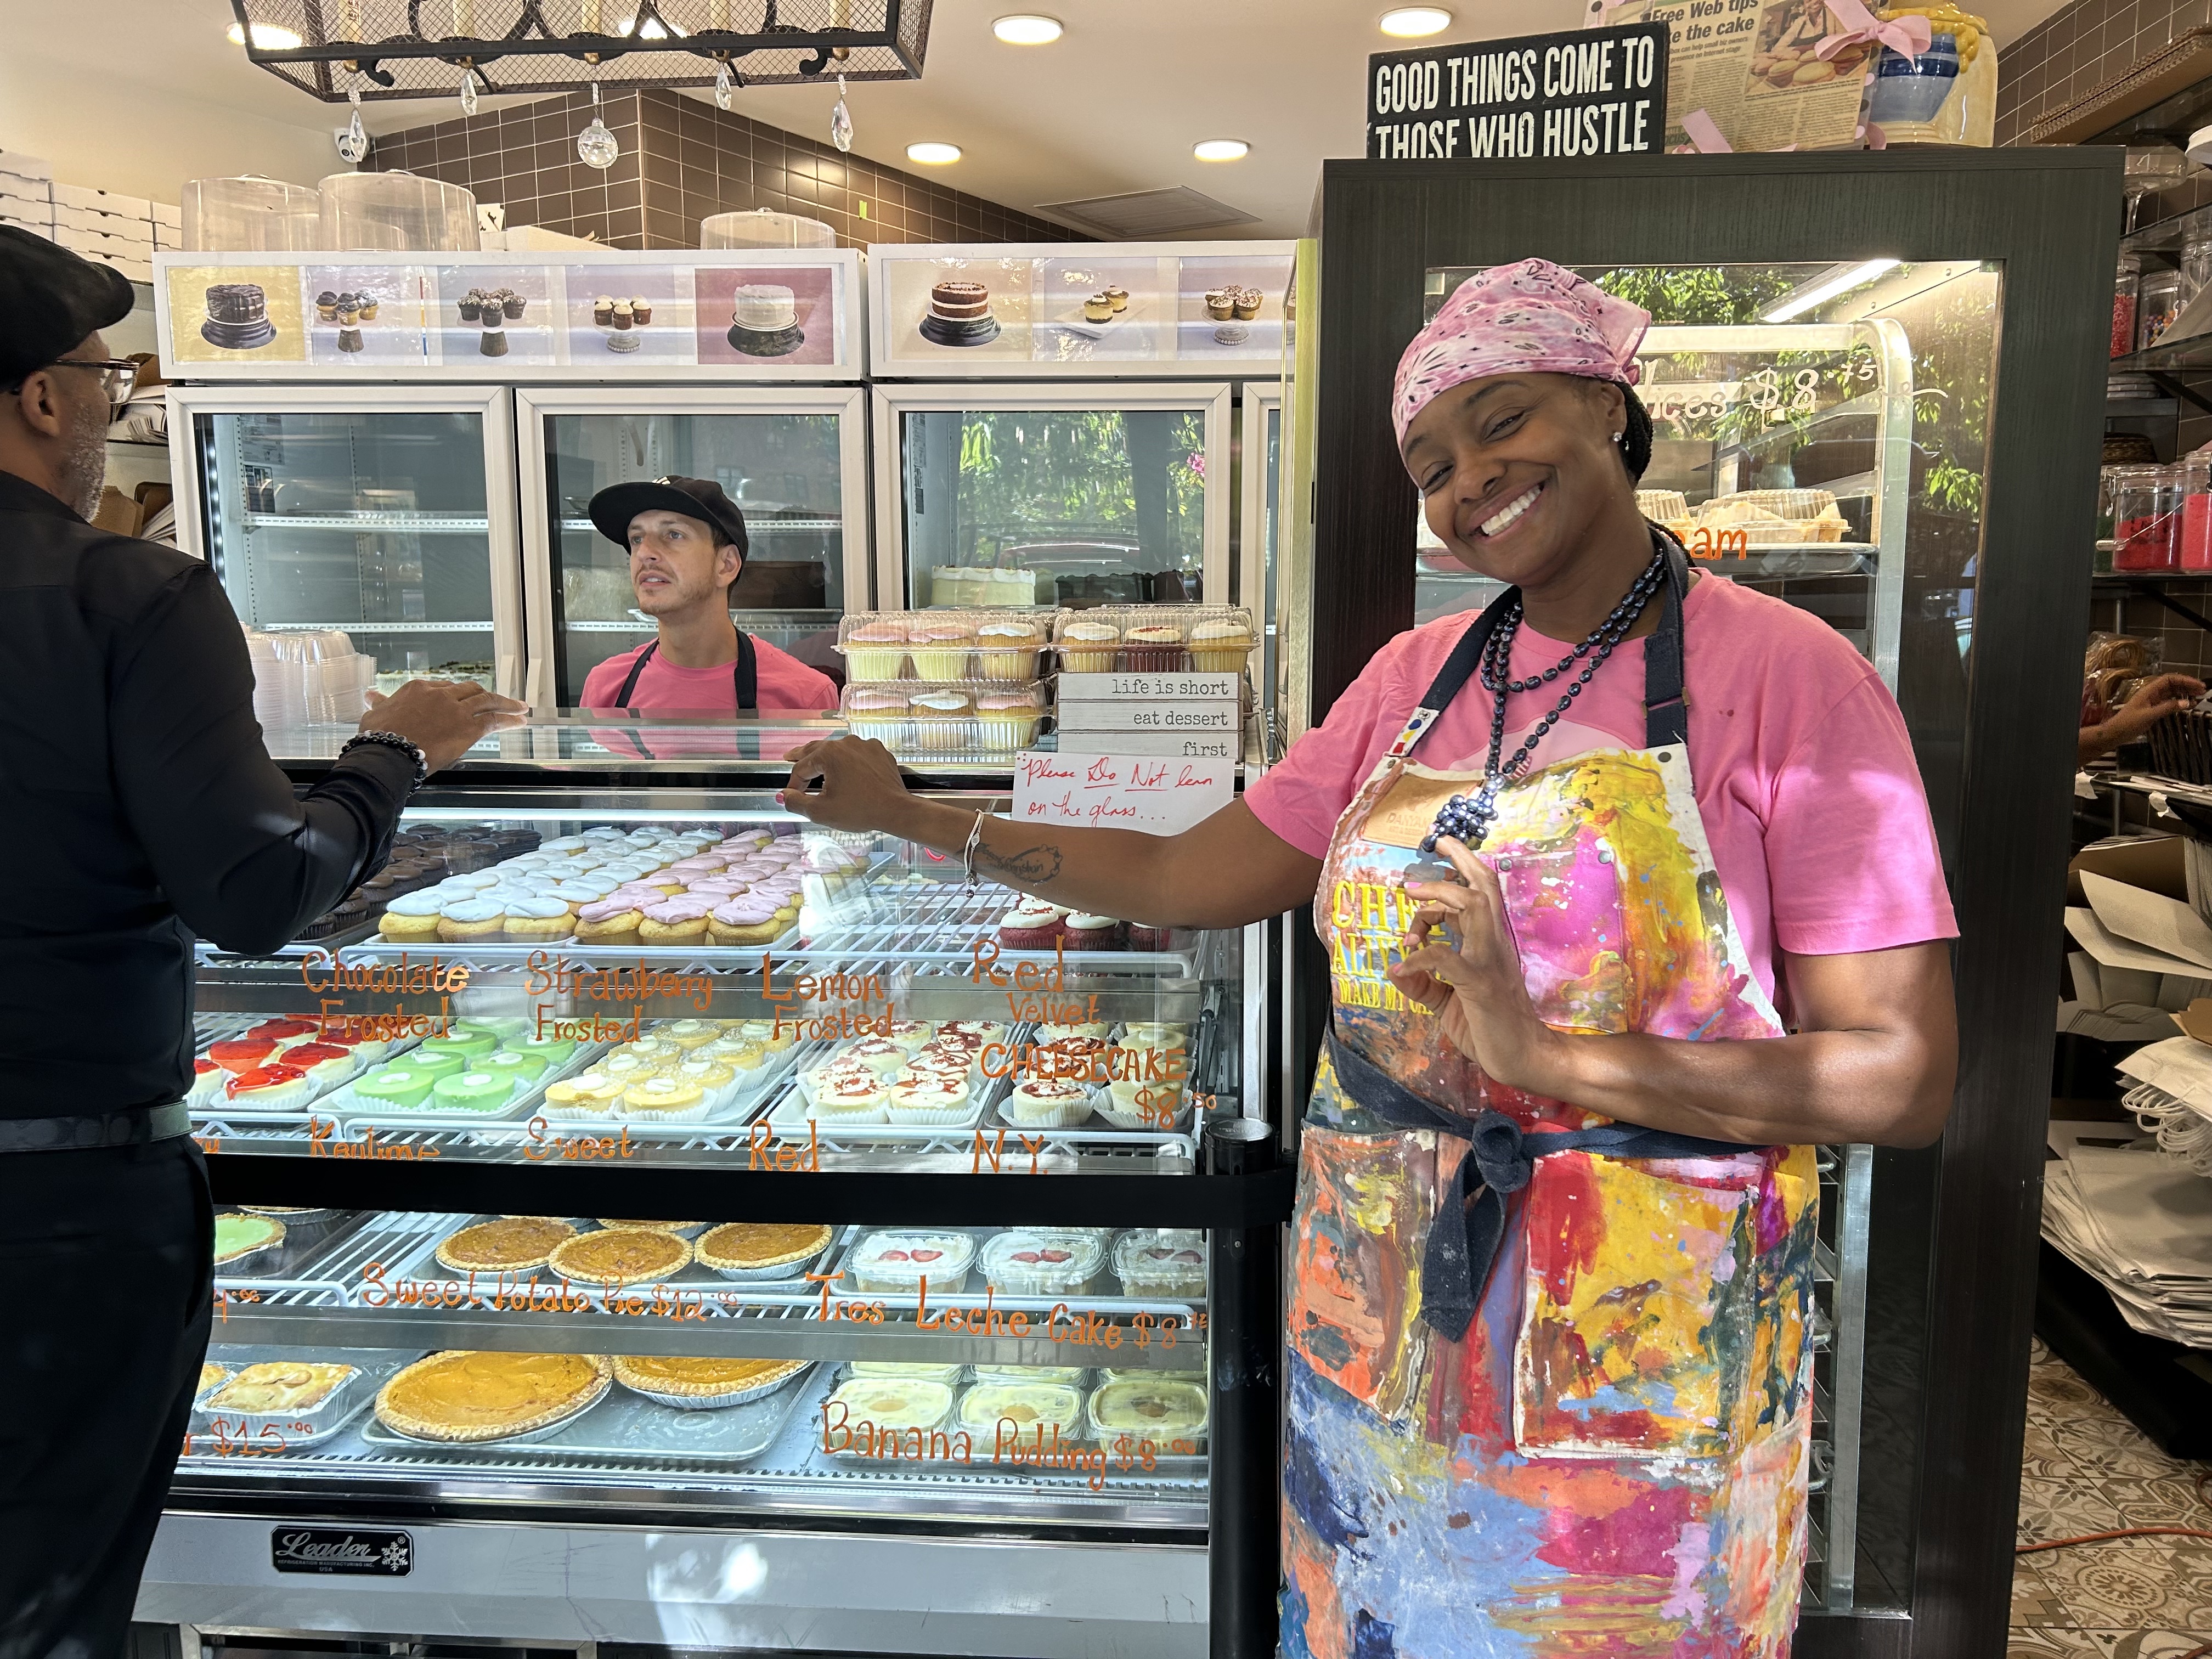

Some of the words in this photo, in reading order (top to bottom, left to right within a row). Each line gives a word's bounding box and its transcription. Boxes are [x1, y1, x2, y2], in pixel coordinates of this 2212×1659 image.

[1652, 9, 1684, 22] Free
[1690, 0, 1723, 18] Web
[1729, 0, 1758, 14] tips
[1686, 24, 1711, 41] the
[1717, 16, 1754, 35] cake
[1376, 60, 1440, 114] GOOD
[1447, 48, 1536, 108] THINGS
[1544, 40, 1613, 98] COME
[1622, 35, 1655, 88] TO
[1375, 118, 1460, 159] THOSE
[1469, 111, 1534, 158] WHO
[1544, 100, 1650, 157] HUSTLE
[1632, 357, 1727, 420] lices
[1111, 679, 1149, 695] life
[1155, 678, 1173, 695] is
[1180, 679, 1229, 695] short
[1133, 711, 1160, 725] eat
[1165, 711, 1228, 726] dessert
[1182, 742, 1228, 757] first
[1021, 758, 1076, 787] Please
[1087, 757, 1117, 782] Do
[1131, 761, 1169, 787] Not
[1175, 764, 1213, 788] lean
[1028, 801, 1046, 817] on
[1052, 791, 1081, 817] the
[302, 948, 470, 995] Chocolate
[525, 950, 713, 1011] Strawberry
[761, 952, 884, 1002] Lemon
[972, 934, 1065, 993] Red
[1006, 991, 1101, 1031] Velvet
[1337, 977, 1381, 1009] MAKE
[319, 996, 450, 1042] Frosted
[535, 1003, 643, 1043] Frosted
[772, 1002, 895, 1042] Frosted
[980, 1042, 1187, 1084] CHEESECAKE
[524, 1116, 634, 1161] Sweet
[748, 1118, 820, 1173] Red
[362, 1262, 483, 1307] Sweet
[493, 1270, 591, 1313] Potato
[603, 1271, 645, 1316] Pie
[805, 1270, 887, 1325] Tres
[915, 1274, 1031, 1338] Leche
[1048, 1302, 1124, 1350] Cake
[820, 1400, 973, 1465] Banana
[992, 1416, 1108, 1492] Pudding
[275, 1532, 382, 1562] Leader
